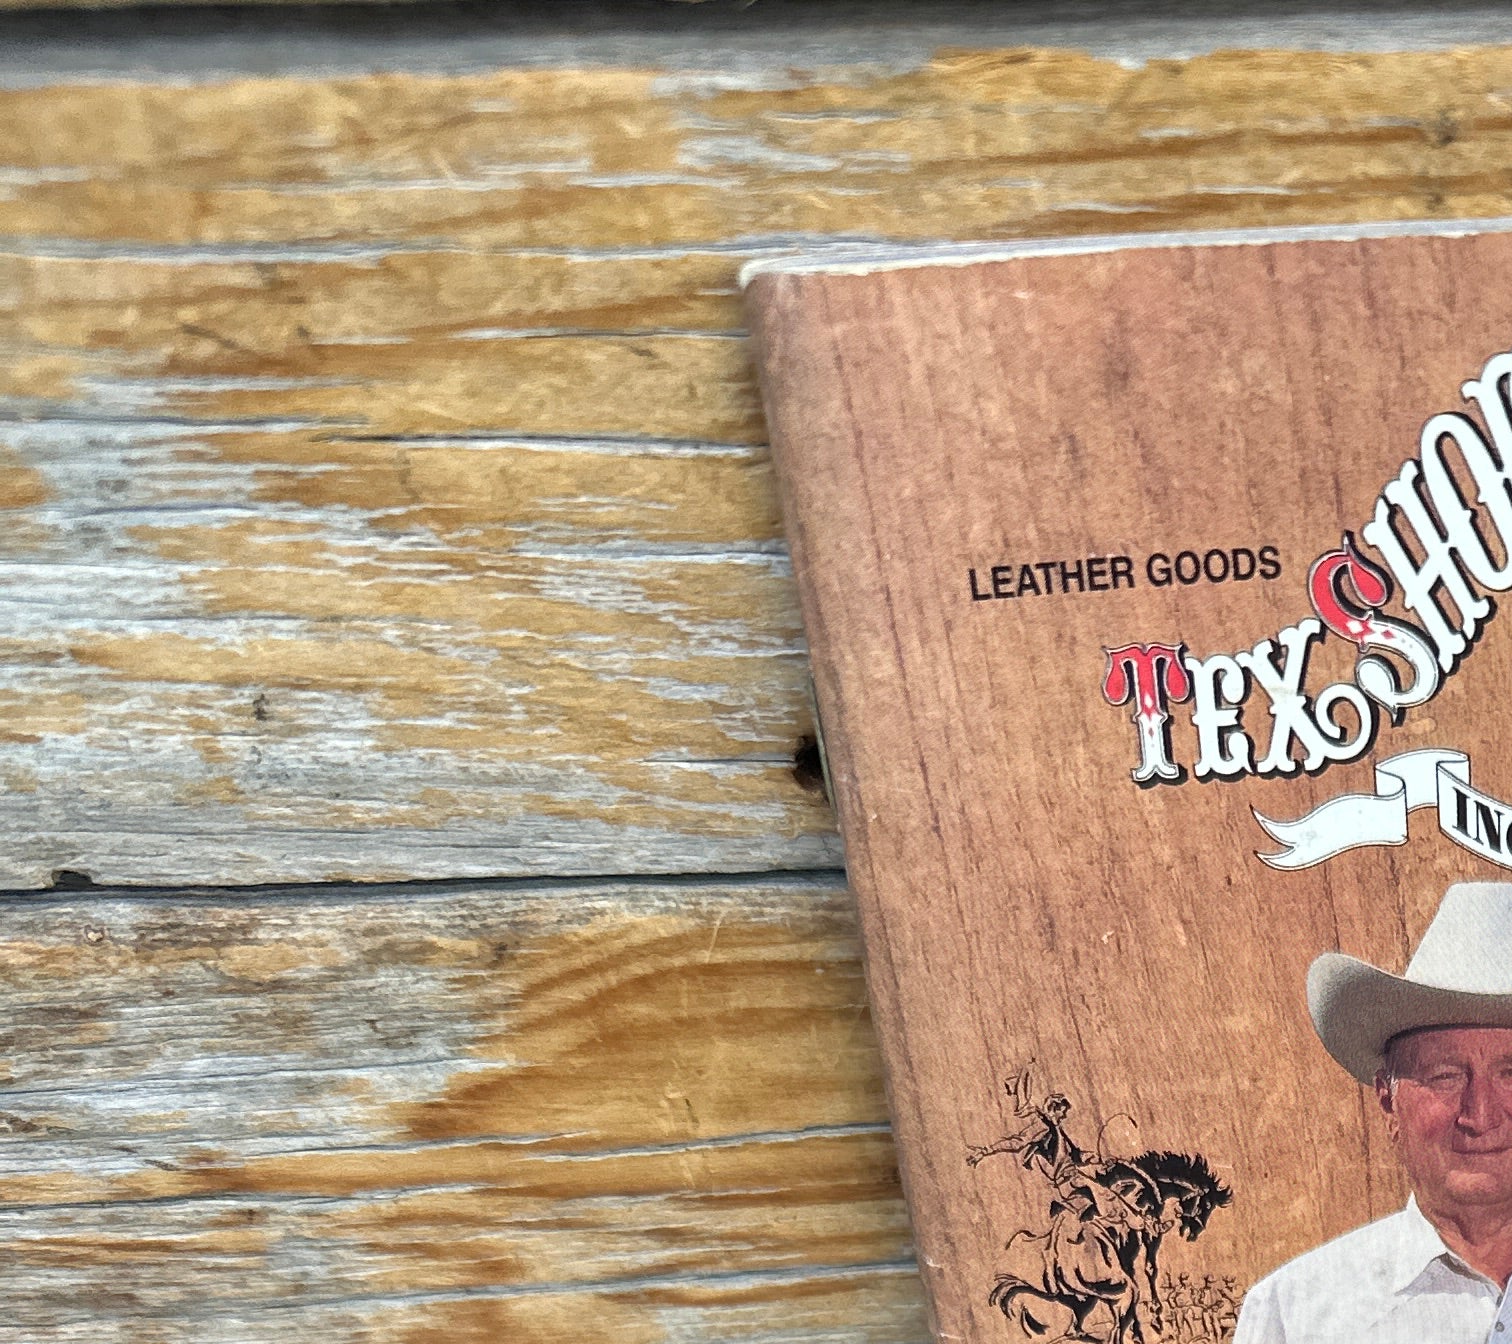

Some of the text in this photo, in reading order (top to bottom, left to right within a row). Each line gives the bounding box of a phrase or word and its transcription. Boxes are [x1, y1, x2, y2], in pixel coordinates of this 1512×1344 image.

[967, 546, 1283, 602] LEATHER GOODS
[1103, 619, 1376, 788] TEX
